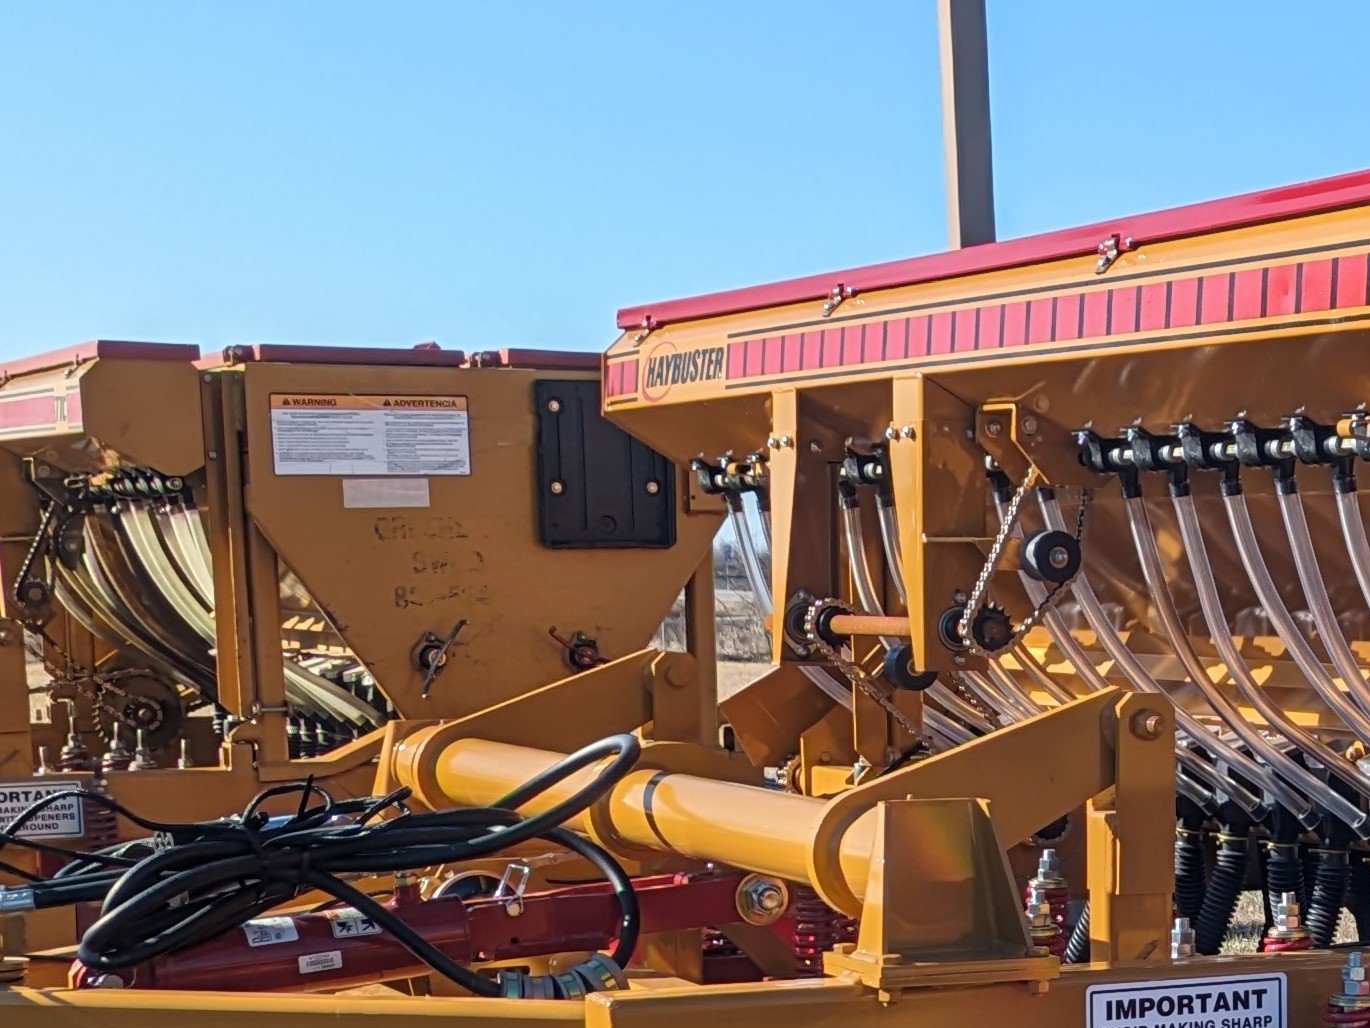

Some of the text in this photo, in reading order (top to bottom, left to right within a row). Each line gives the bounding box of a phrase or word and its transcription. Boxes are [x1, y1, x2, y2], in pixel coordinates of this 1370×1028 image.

[646, 346, 725, 389] HAYBUSTER
[292, 398, 337, 407] WARNING
[393, 399, 457, 409] ADVERTENCIA
[1106, 988, 1268, 1021] IMPORTANT
